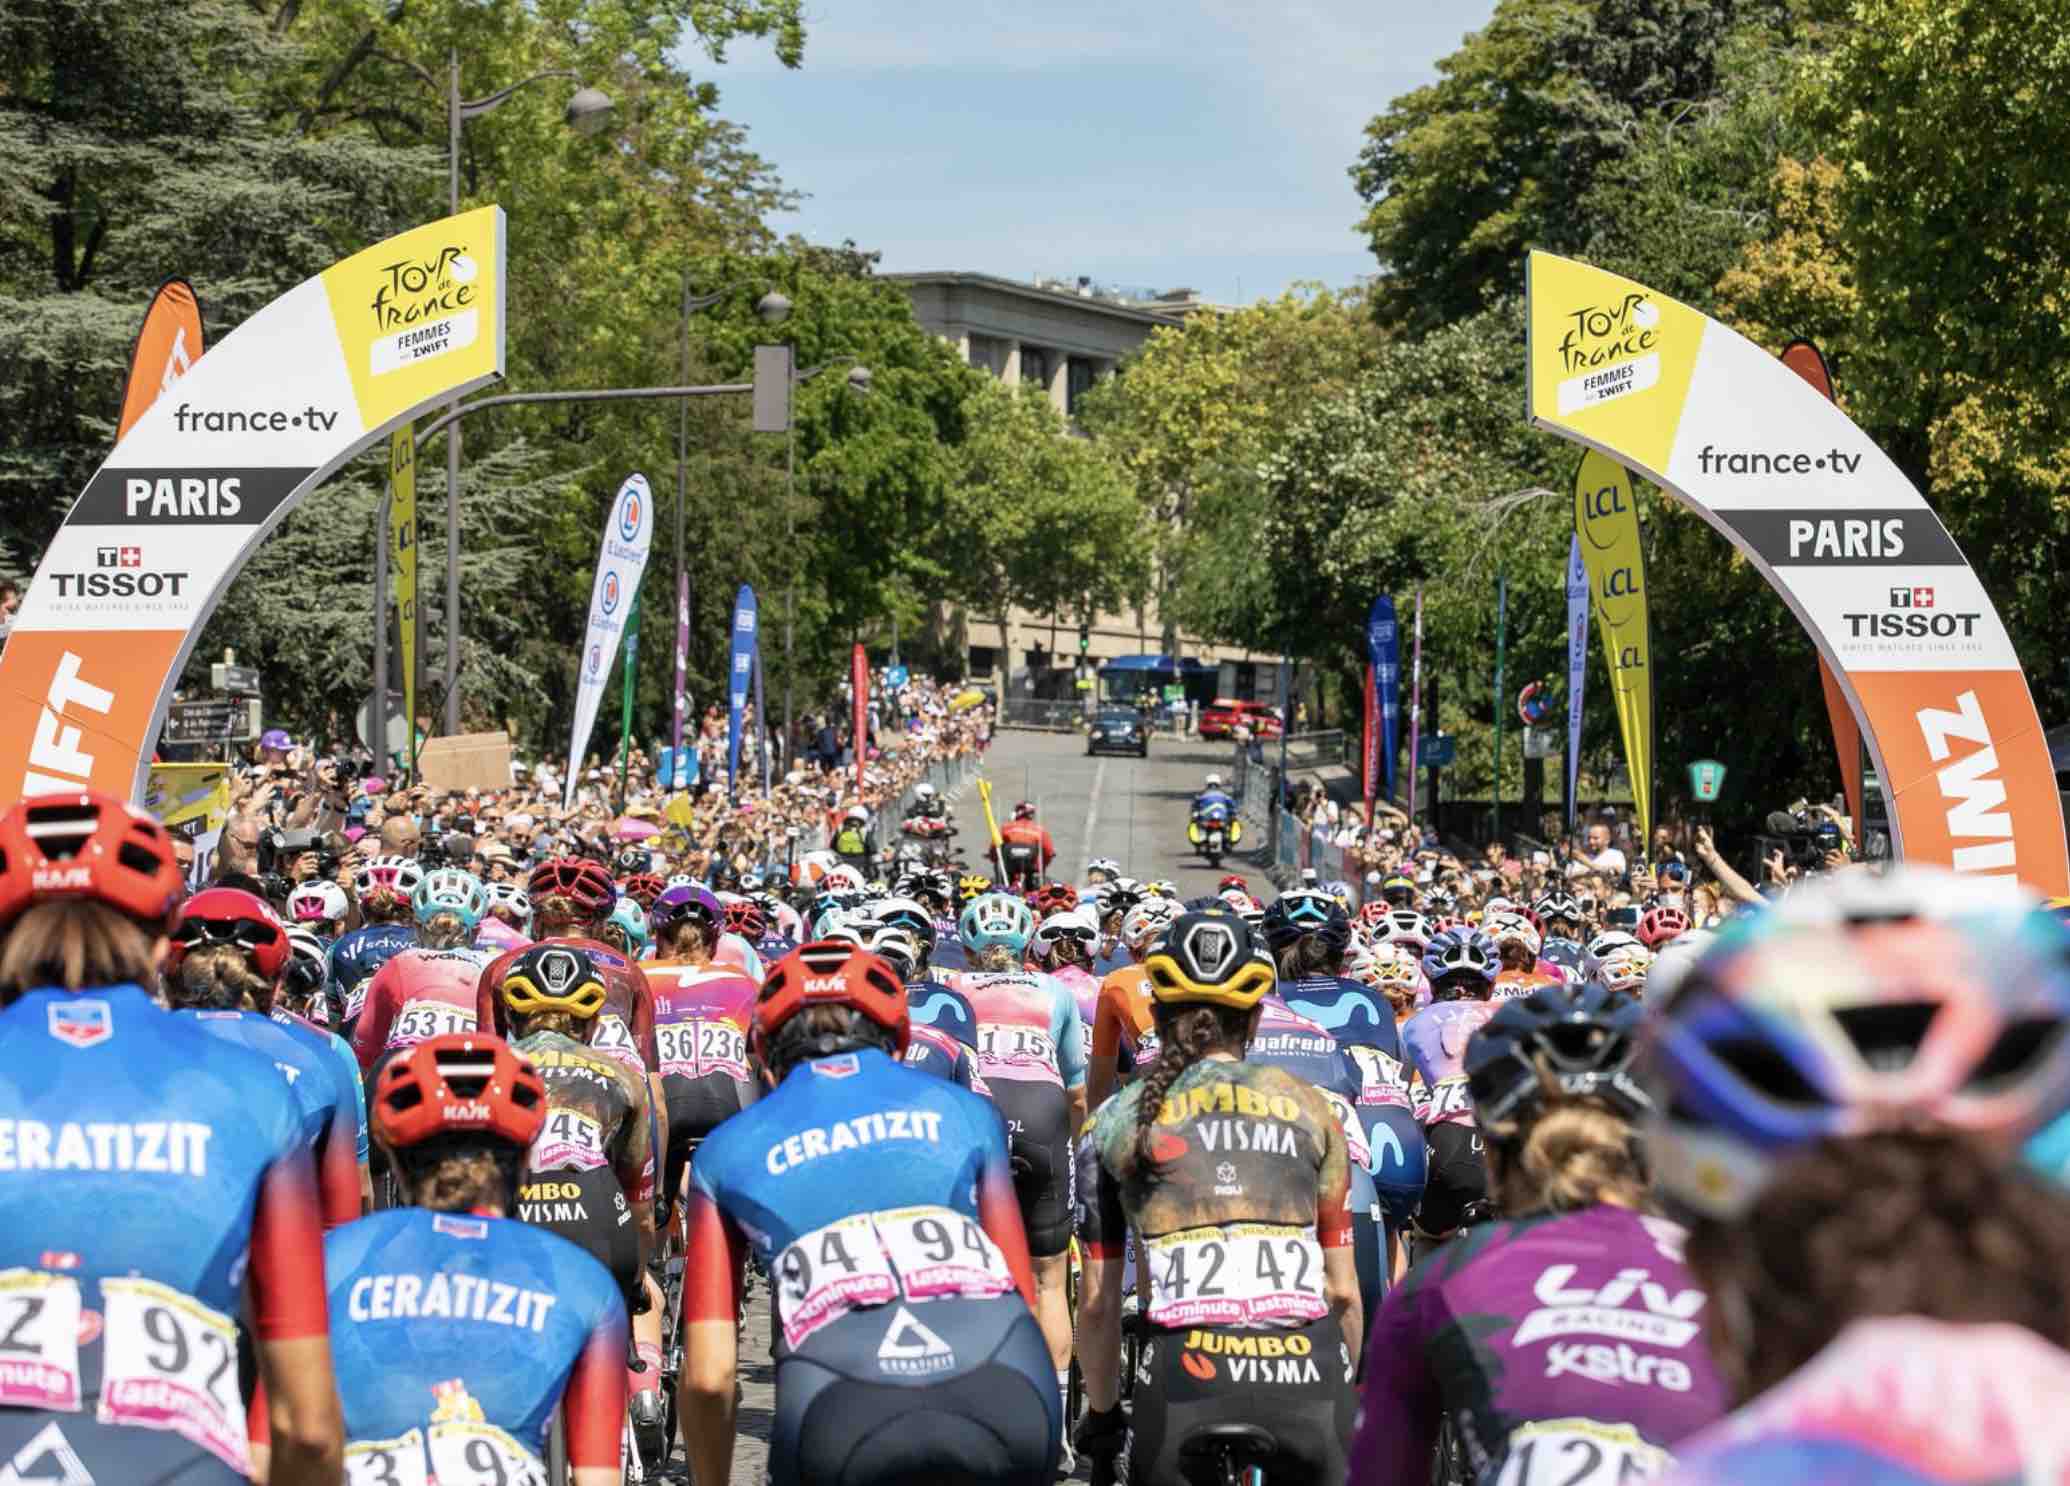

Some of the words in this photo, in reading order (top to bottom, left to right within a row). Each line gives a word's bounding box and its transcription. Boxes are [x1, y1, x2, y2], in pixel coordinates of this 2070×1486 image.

[398, 321, 451, 349] FEMMES
[412, 338, 449, 357] ZWIFT
[1583, 364, 1634, 390] FEMMES
[1597, 381, 1632, 398] ZWIFT
[127, 478, 241, 517] PARIS
[1584, 486, 1627, 521] LCL
[1789, 519, 1904, 558] PARIS
[50, 573, 188, 597] TISSOT
[1843, 614, 1981, 637] TISSOT
[22, 650, 115, 800] IFT
[1915, 689, 2019, 888] ZWI
[662, 1030, 693, 1060] 36
[702, 1029, 745, 1063] 236
[1246, 1034, 1337, 1056] gafredo
[527, 1051, 616, 1079] MBO
[550, 1114, 594, 1147] 45
[766, 1110, 943, 1177] CERATIZIT
[1196, 1119, 1298, 1158] VISMA
[0, 1119, 212, 1177] ERATIZIT
[520, 1183, 581, 1201] MBO
[518, 1202, 588, 1222] VISMA
[912, 1218, 992, 1269] 94
[1165, 1242, 1225, 1299] 42
[1255, 1239, 1316, 1293] 42
[349, 1271, 556, 1333] CERATIZIT
[0, 1297, 46, 1354] 2
[1184, 1330, 1312, 1357] JUMBO
[1227, 1358, 1321, 1383] VISMA
